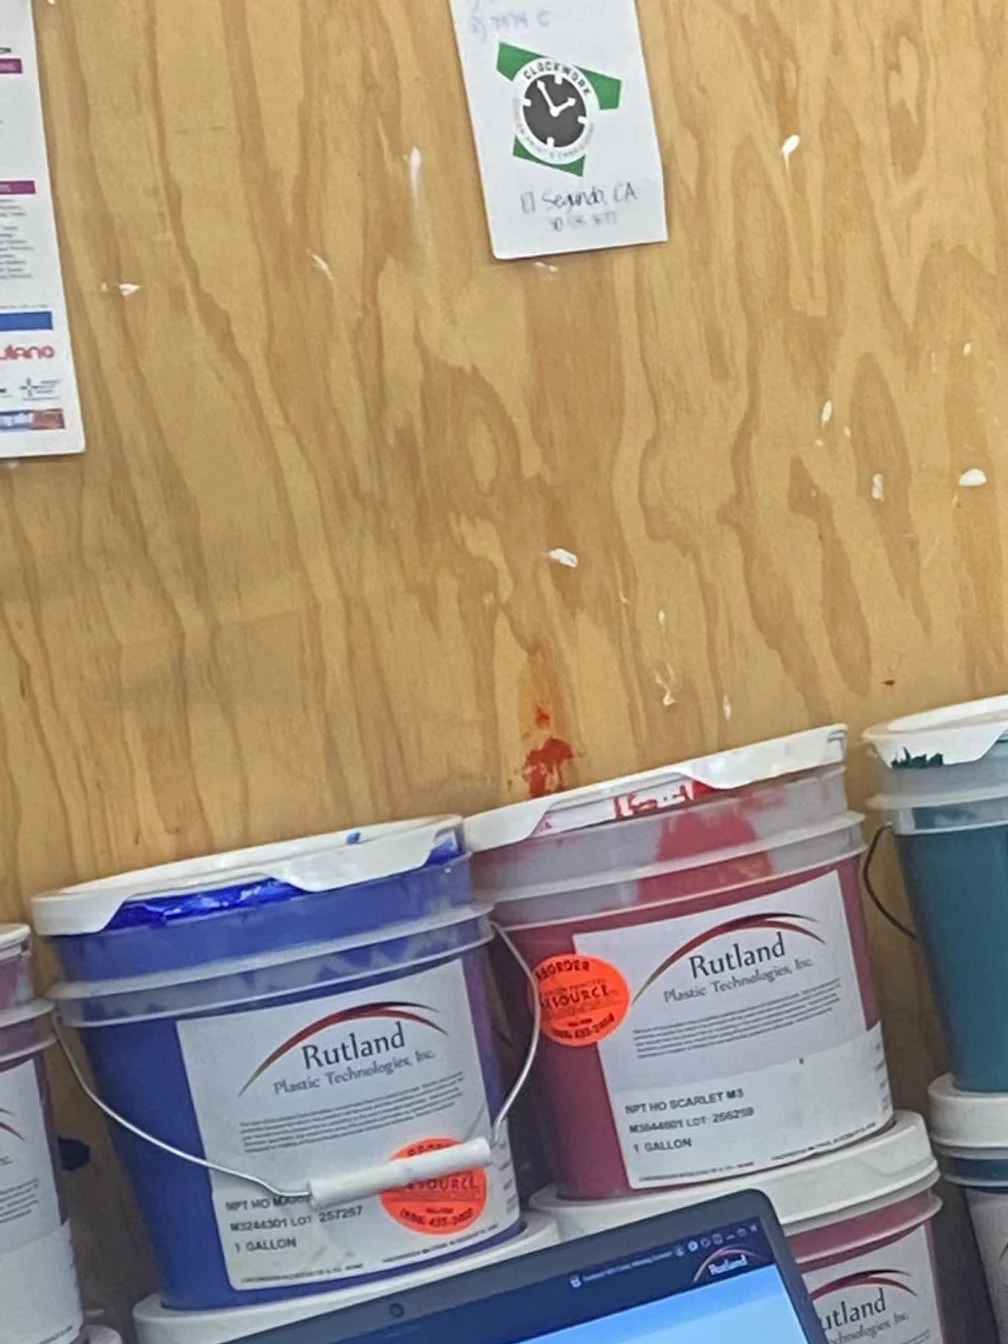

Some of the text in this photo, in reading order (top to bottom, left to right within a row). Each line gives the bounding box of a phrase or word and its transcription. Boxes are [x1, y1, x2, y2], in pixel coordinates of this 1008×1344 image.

[523, 60, 592, 96] CLOCKWORK
[688, 931, 786, 979] Rutland
[663, 986, 707, 1003] Plastic
[301, 1020, 406, 1070] Rutland
[273, 1076, 321, 1096] Plastic
[649, 1101, 668, 1112] HO
[669, 1091, 724, 1110] SCARLET
[644, 1138, 692, 1152] GALLON
[246, 1237, 297, 1252] GALLON
[709, 1254, 749, 1275] Rutland
[825, 1287, 887, 1330] utland
